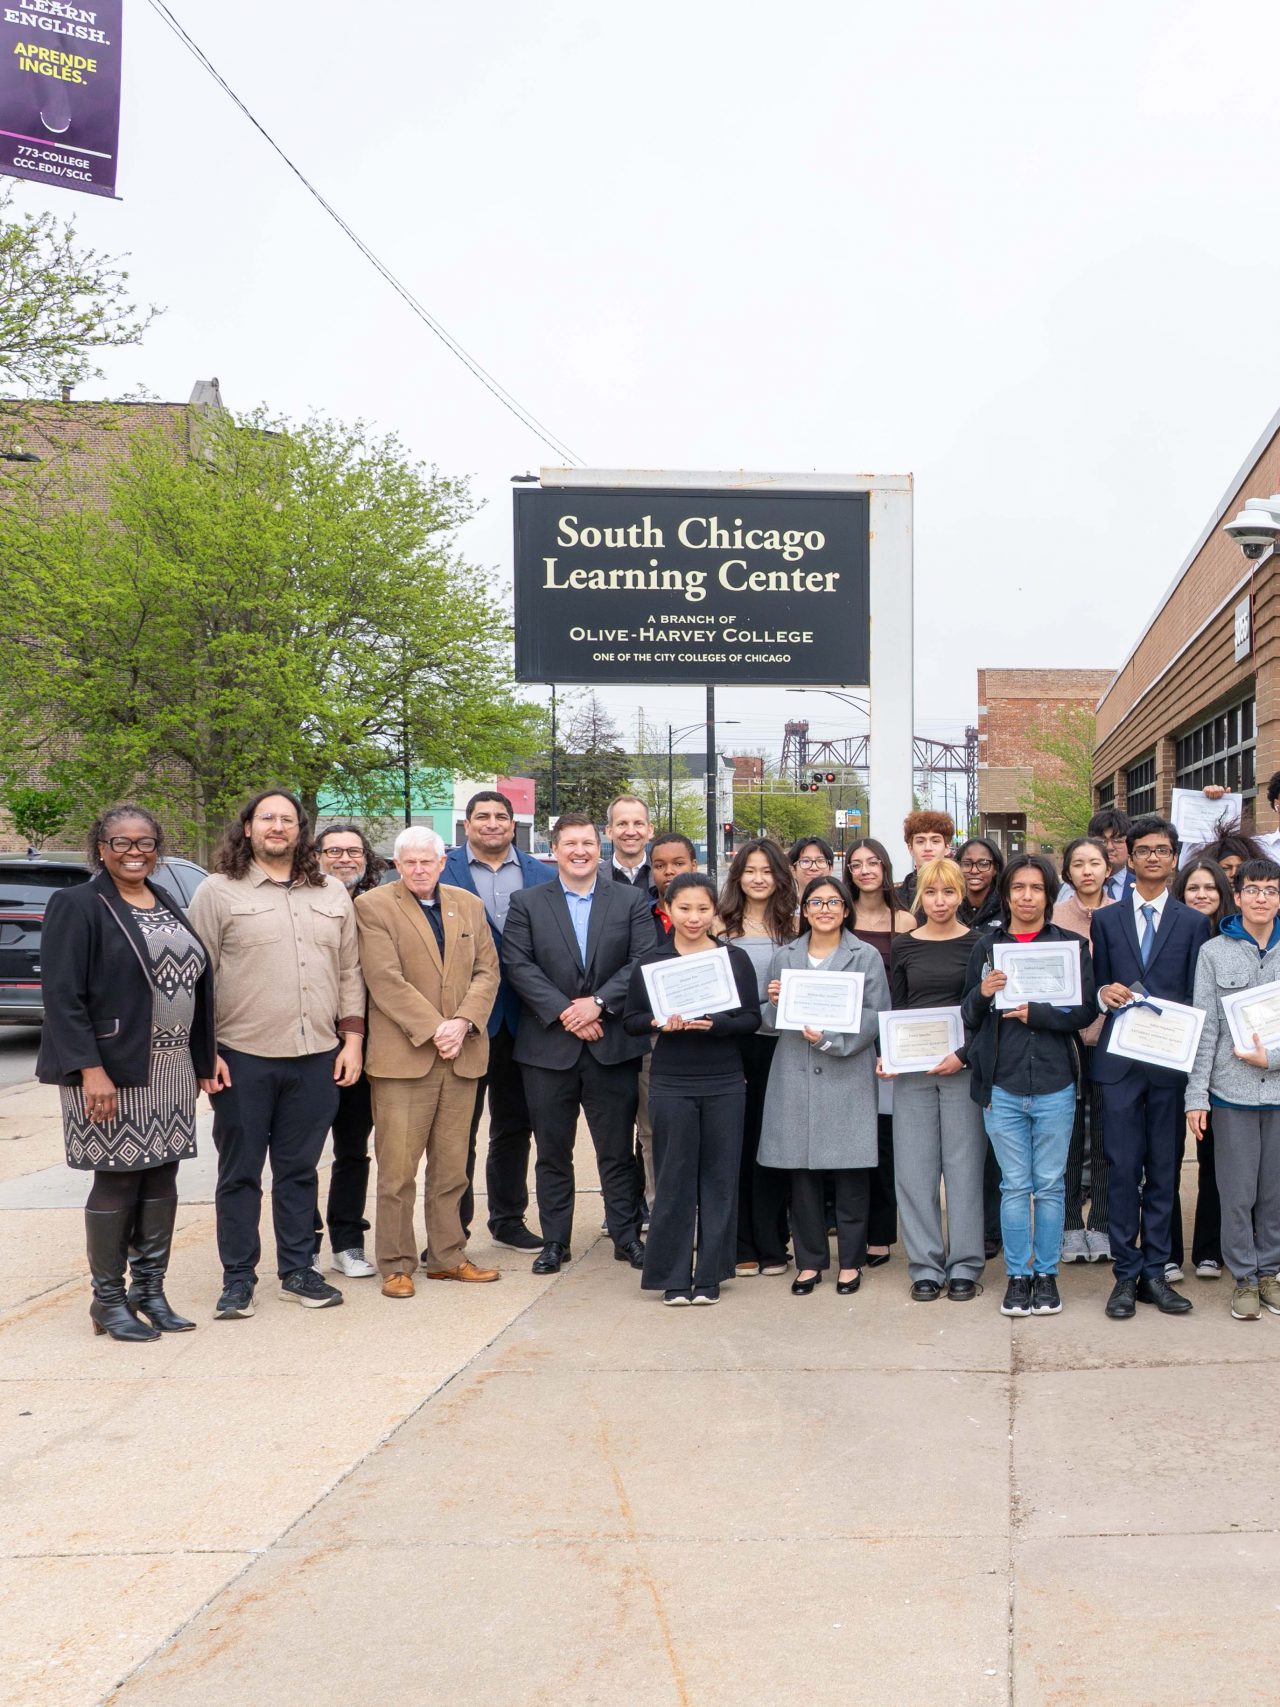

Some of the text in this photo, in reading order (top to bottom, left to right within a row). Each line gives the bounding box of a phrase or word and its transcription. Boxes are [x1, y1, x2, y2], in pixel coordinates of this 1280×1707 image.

[19, 0, 97, 26] LEARN
[4, 8, 111, 46] ENGLISH.
[14, 42, 97, 73] APRENDE
[19, 56, 87, 85] INGLÉS.
[13, 157, 92, 182] CCC.EDU/SCLC
[17, 145, 90, 169] 773-COLLEGE
[556, 514, 826, 562] South Chicago
[542, 557, 841, 602] Learning Center
[647, 614, 737, 625] A BRANCH OF
[569, 626, 814, 644] OLIVE-HARVEY COLLEGE
[592, 652, 792, 663] ONE OF THE CITY COLLEGES OF CHICAGO
